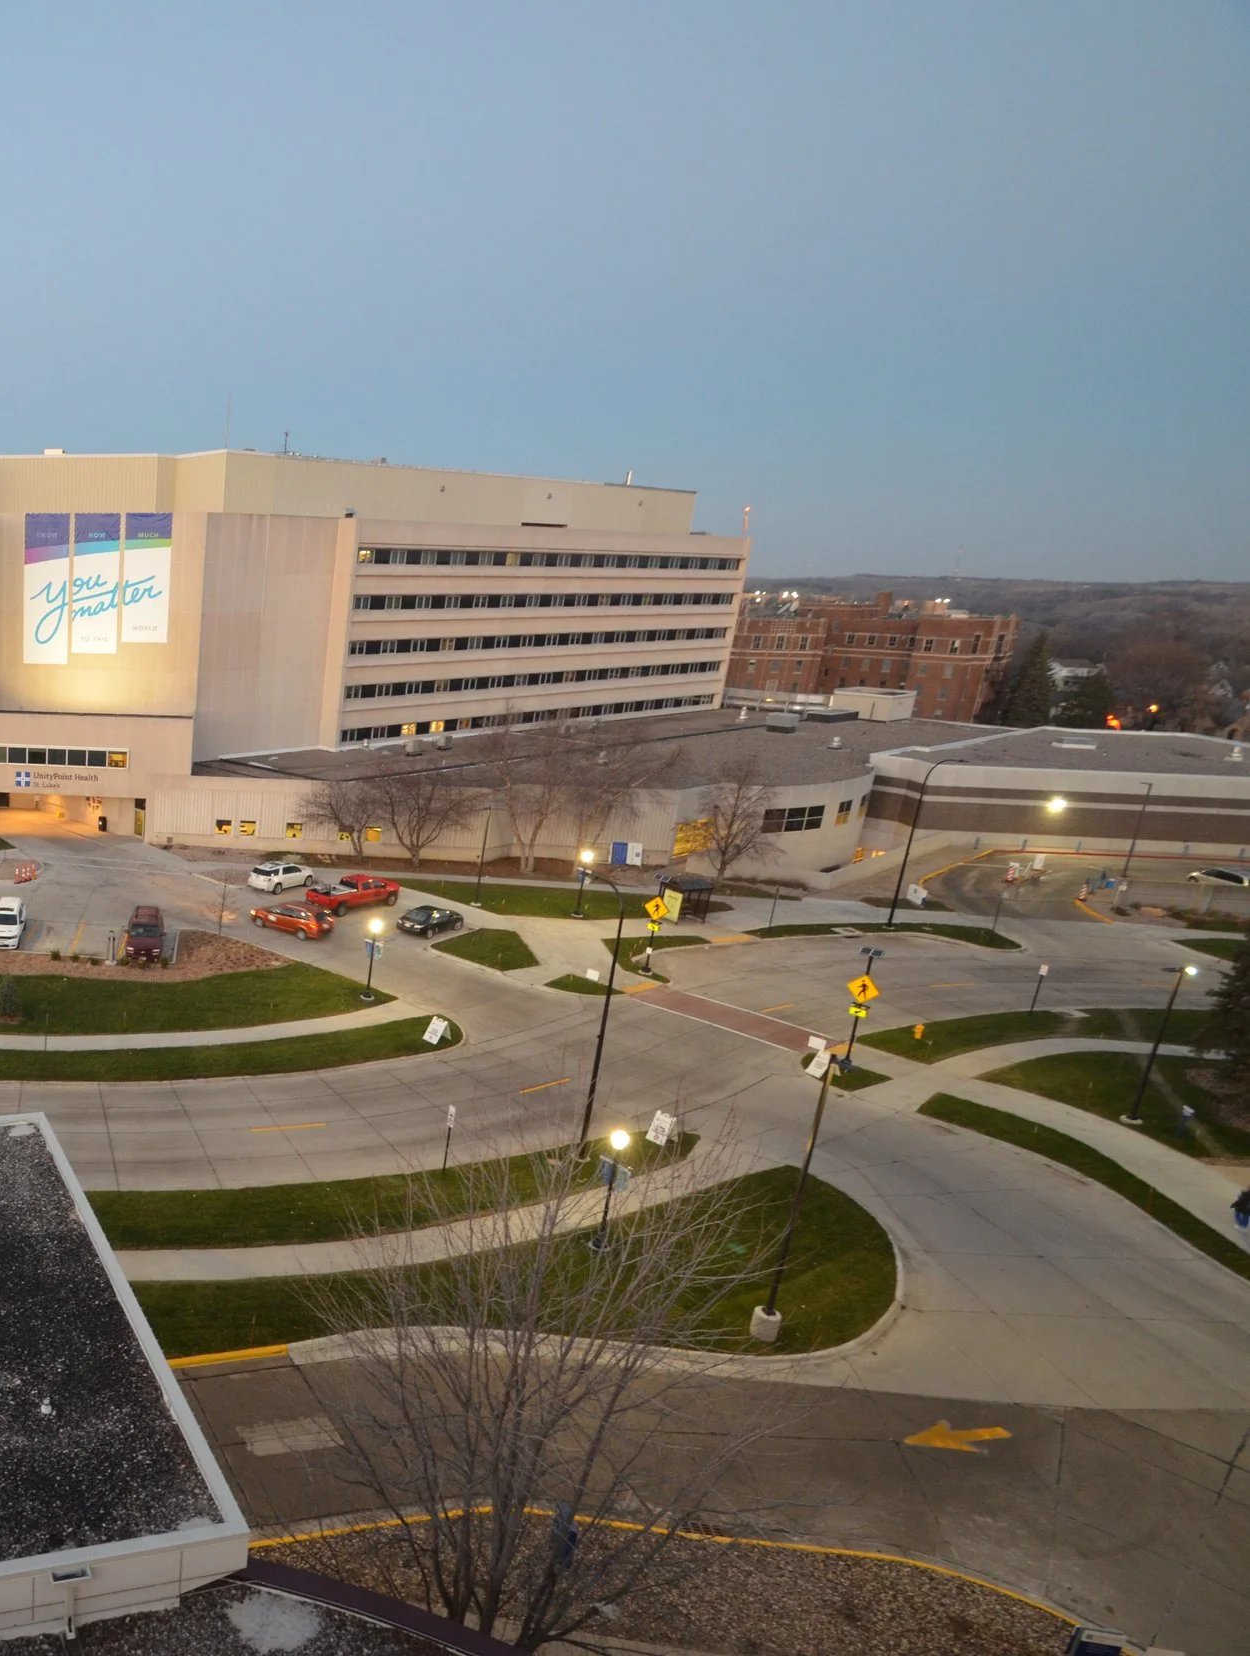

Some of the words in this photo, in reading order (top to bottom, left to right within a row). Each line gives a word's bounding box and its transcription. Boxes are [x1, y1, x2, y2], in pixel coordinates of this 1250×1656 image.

[30, 574, 108, 644] you
[71, 575, 162, 622] matter
[33, 772, 72, 780] UnityPoint
[74, 773, 99, 781] Health
